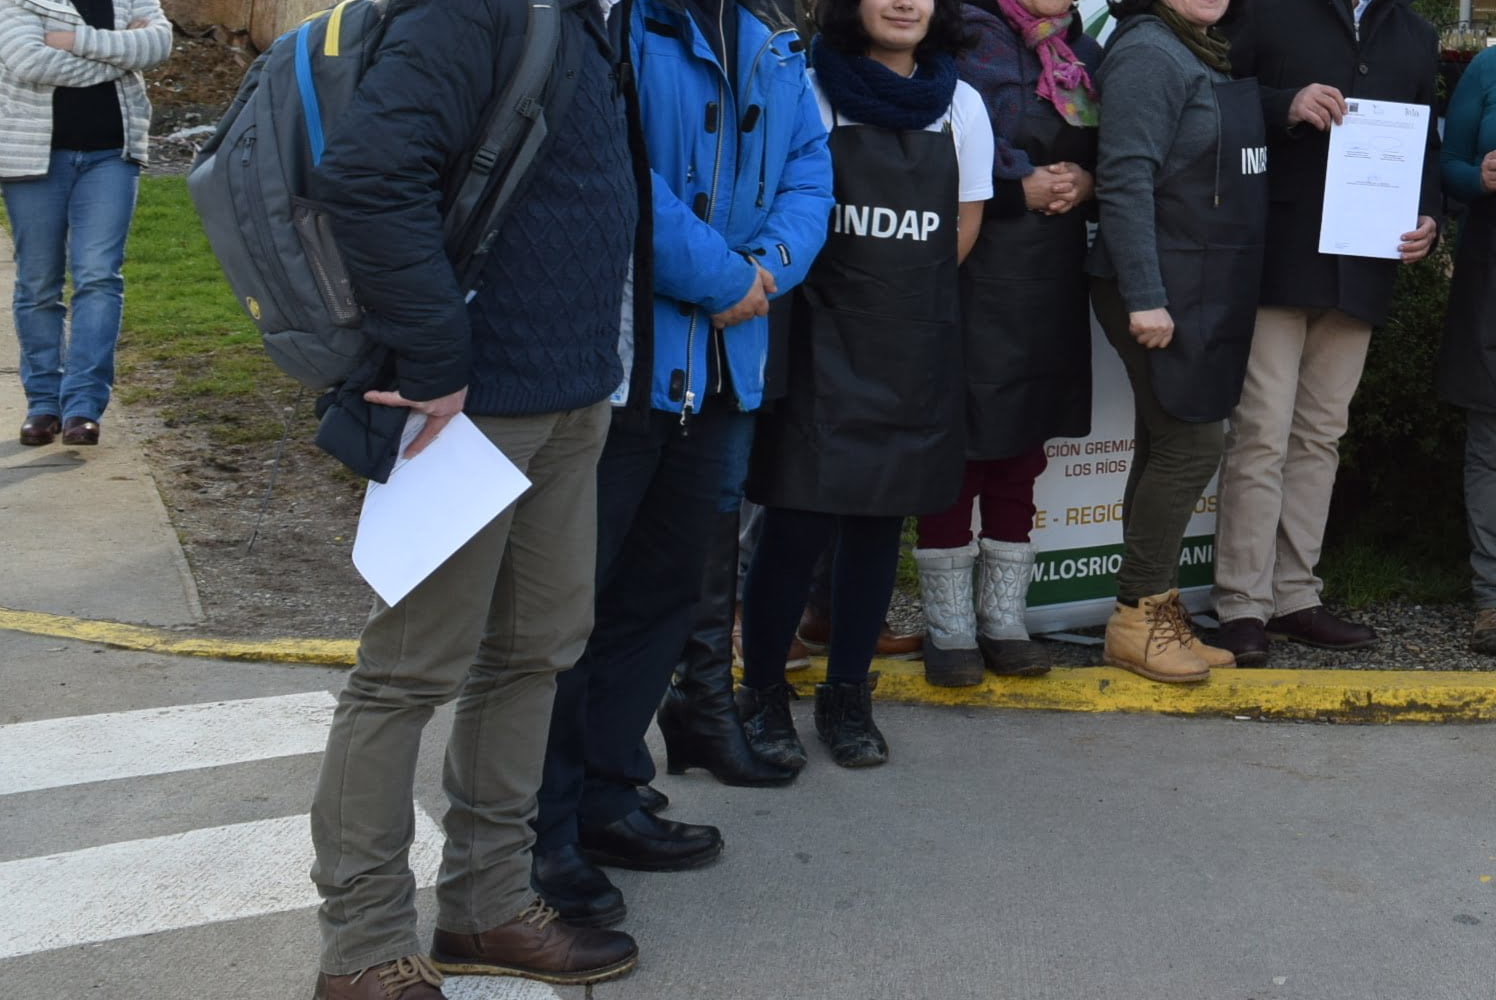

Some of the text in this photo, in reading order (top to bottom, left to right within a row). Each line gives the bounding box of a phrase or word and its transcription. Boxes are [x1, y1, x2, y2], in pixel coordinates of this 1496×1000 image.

[834, 203, 940, 241] INDAP
[1065, 458, 1127, 477] LOS RÍOS
